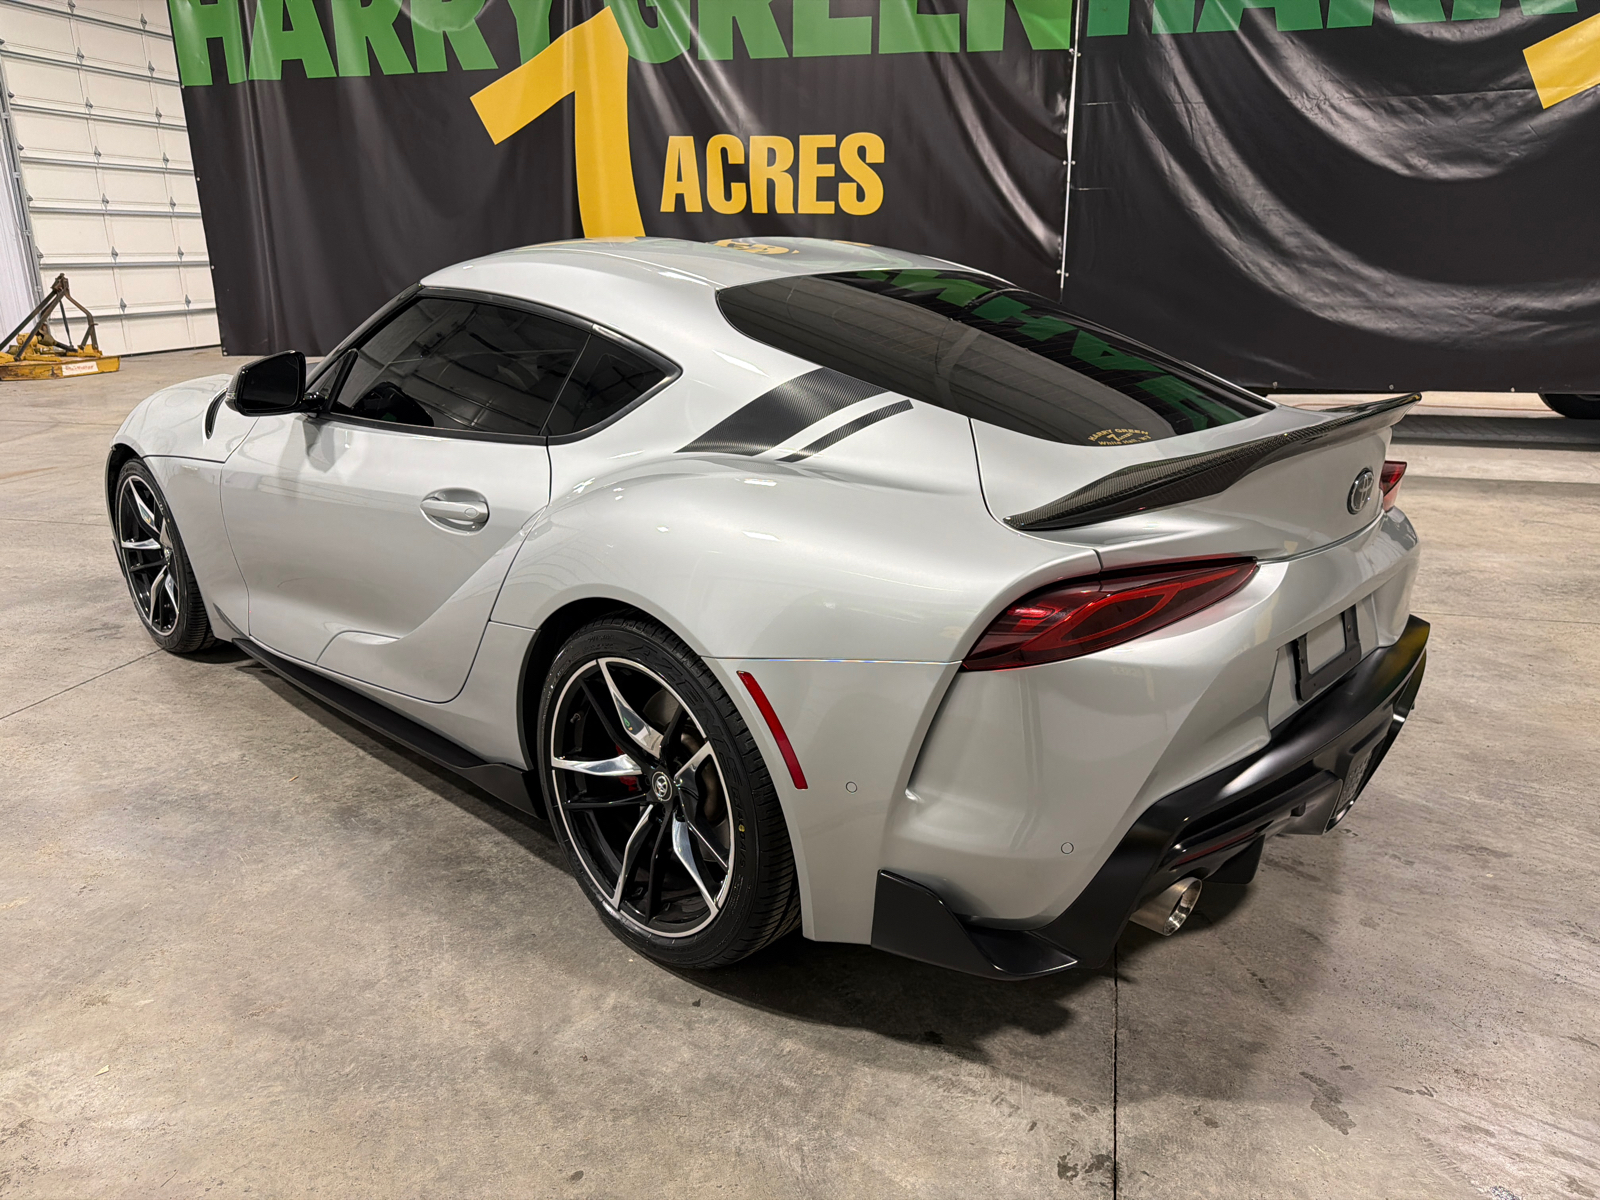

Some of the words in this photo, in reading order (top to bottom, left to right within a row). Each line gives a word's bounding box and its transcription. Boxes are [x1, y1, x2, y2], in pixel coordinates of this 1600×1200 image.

[660, 132, 885, 215] ACRES
[1088, 429, 1113, 441] HARRY
[628, 644, 743, 788] AZENIS
